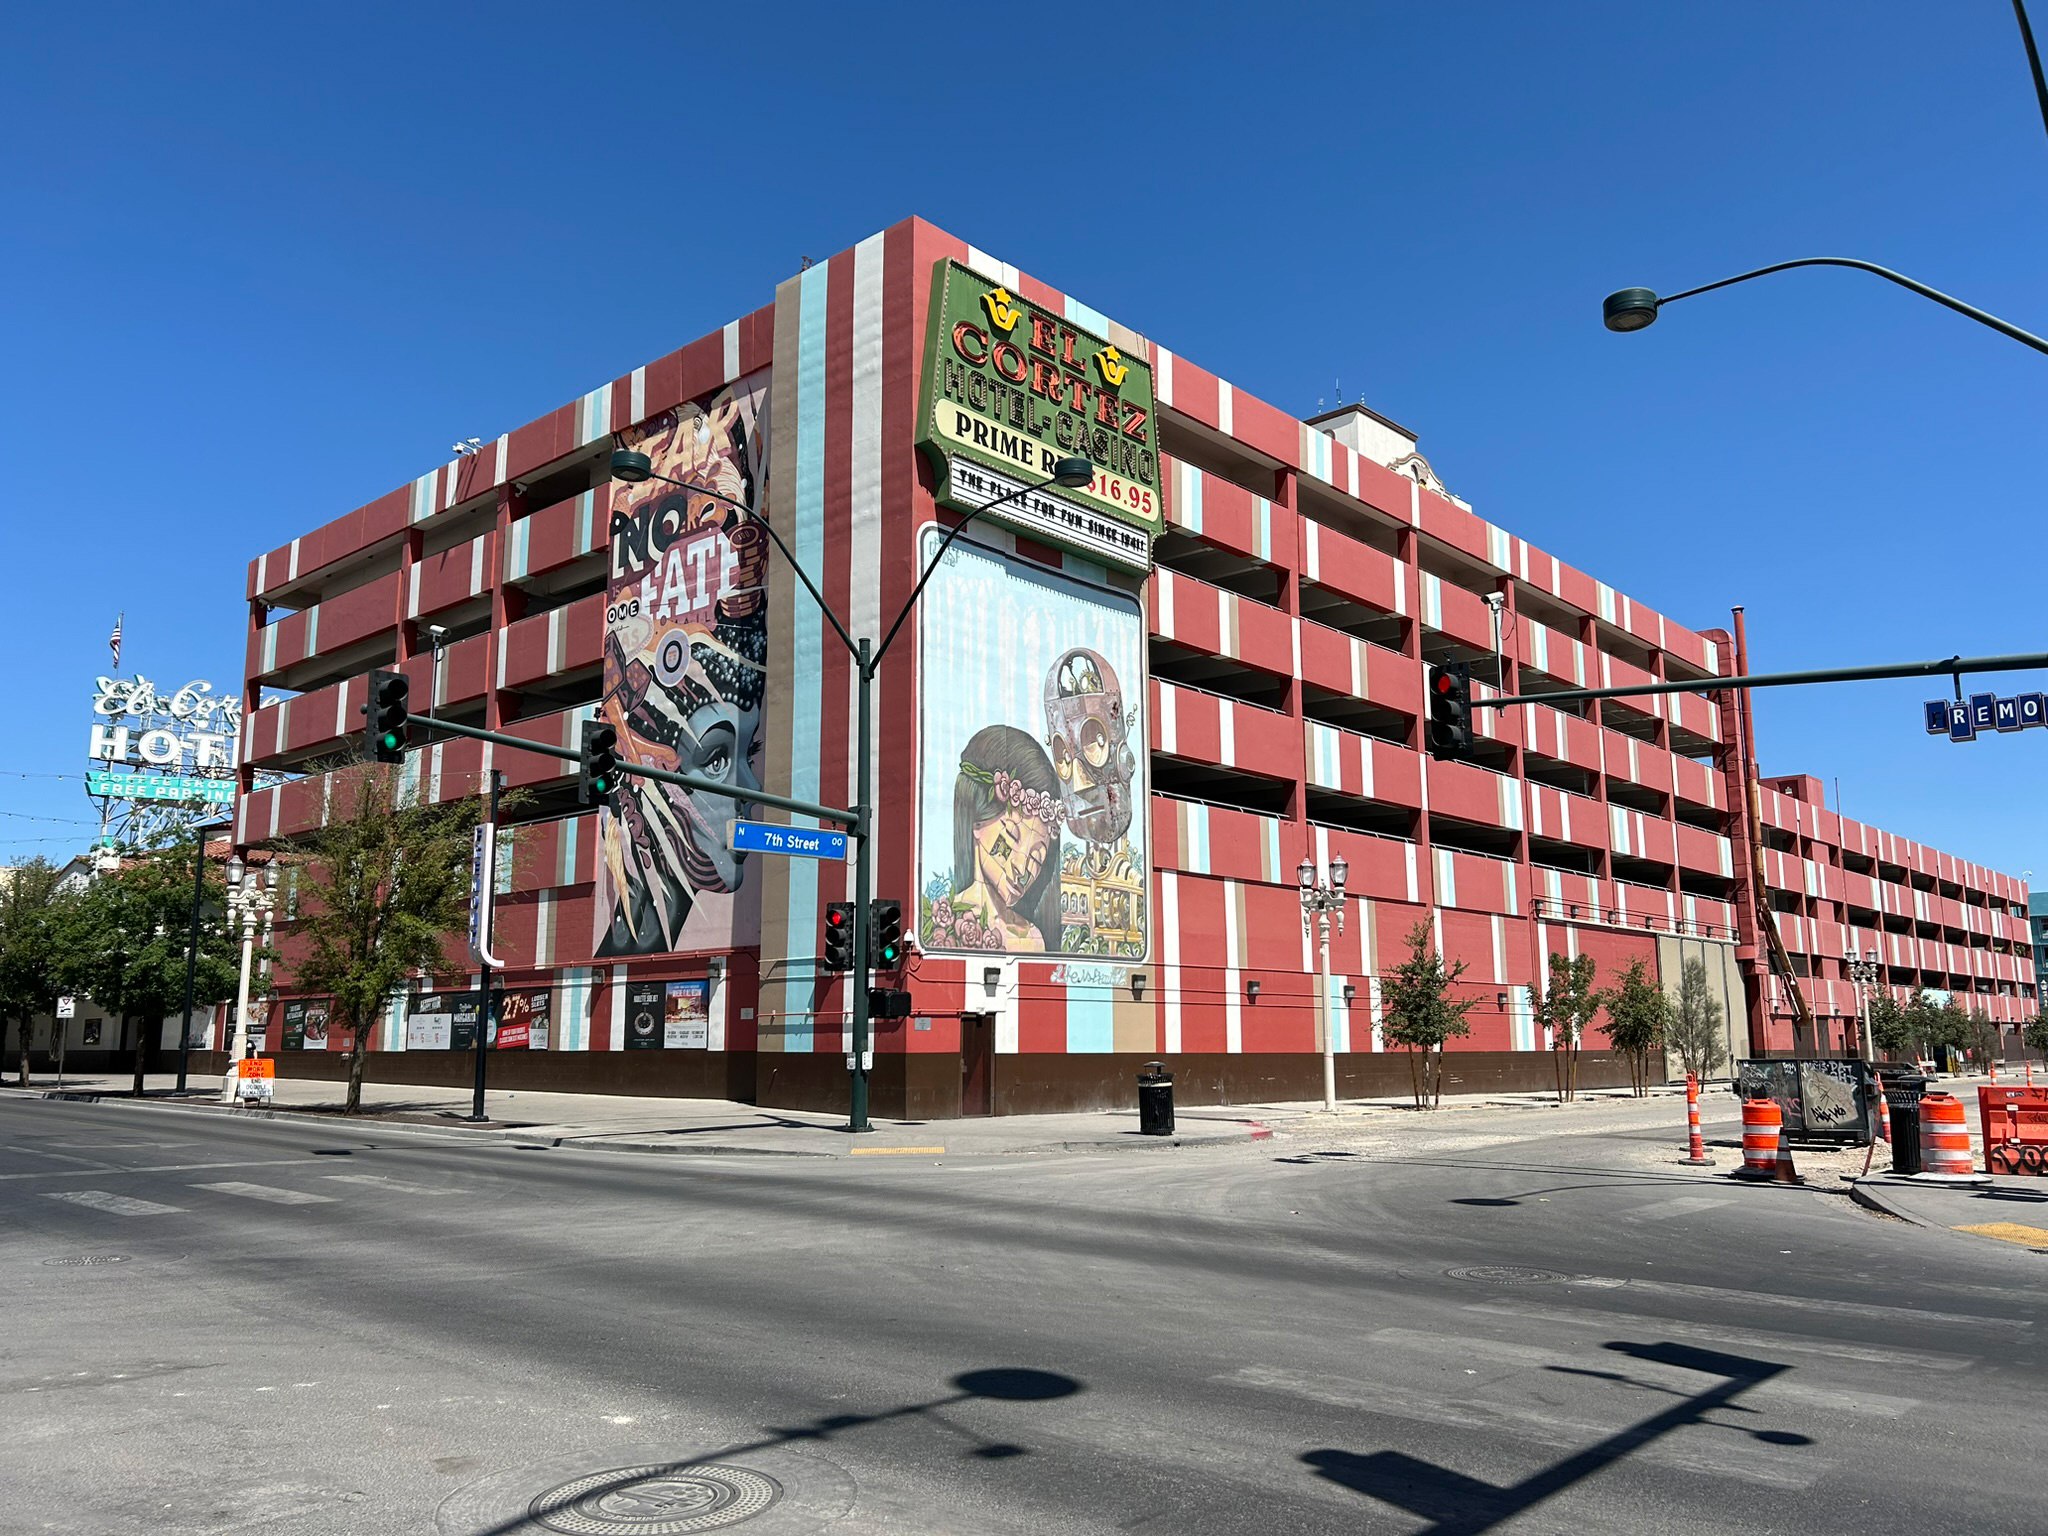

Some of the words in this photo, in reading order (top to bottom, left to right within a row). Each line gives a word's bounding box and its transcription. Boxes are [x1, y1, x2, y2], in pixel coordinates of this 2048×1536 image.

[1028, 312, 1086, 372] EL
[952, 320, 1148, 442] CORTEZ
[955, 410, 1033, 465] PRIME
[959, 468, 983, 492] THE
[990, 480, 1028, 508] PLACE
[1034, 497, 1055, 520] FOR
[1061, 508, 1083, 529] FUN
[1088, 518, 1117, 543] SINCE
[612, 494, 687, 579] NO
[89, 723, 241, 769] HOT
[99, 783, 148, 796] FREE
[738, 827, 746, 836] N
[764, 832, 784, 847] 7th
[787, 835, 820, 851] Street
[503, 994, 530, 1020] 27%
